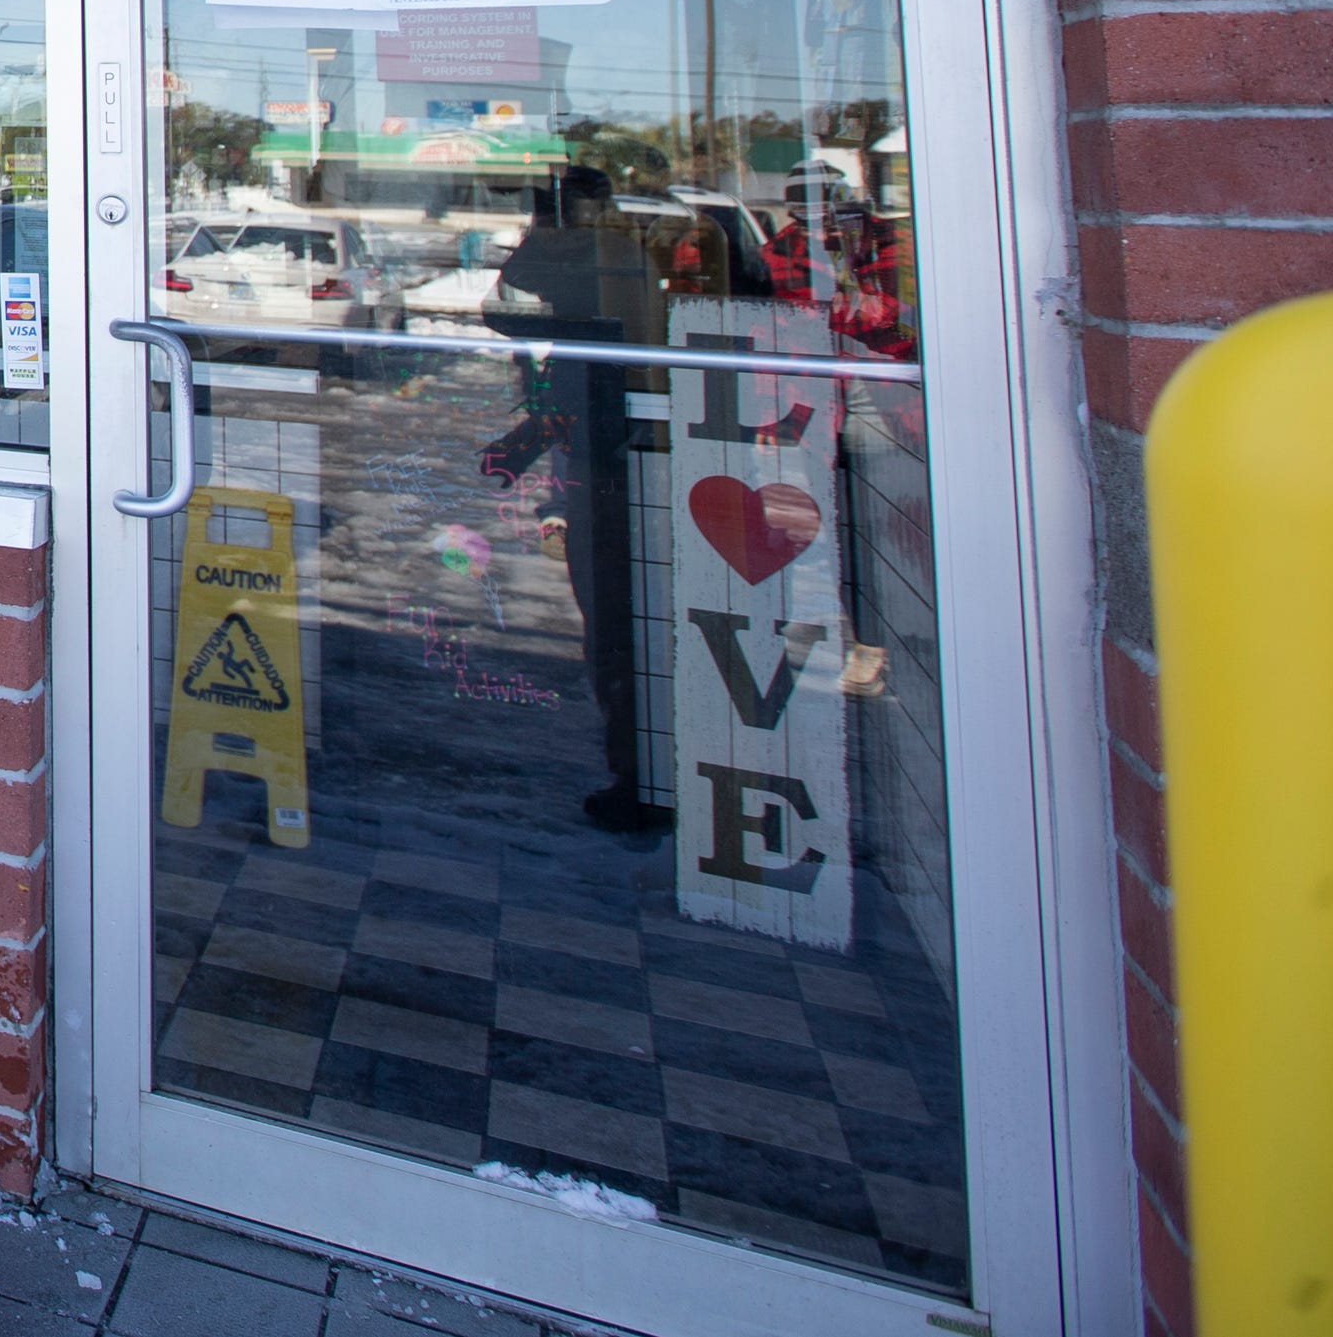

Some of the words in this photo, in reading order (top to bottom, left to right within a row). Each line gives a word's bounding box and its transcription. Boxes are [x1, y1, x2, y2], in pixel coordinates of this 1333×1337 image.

[461, 11, 513, 23] SYSTEM
[517, 11, 532, 21] IN
[408, 27, 436, 37] FOR
[476, 38, 505, 49] AND
[409, 51, 506, 64] INVESTIGATIVE
[422, 65, 494, 76] PURPOSES
[104, 72, 116, 144] PULL
[8, 325, 38, 337] VISA
[195, 564, 282, 593] CAUTION
[386, 593, 454, 635] Fun
[187, 624, 229, 678] CAUTION
[246, 632, 285, 690] CUIDADO
[196, 688, 274, 713] ATTENTION
[453, 668, 561, 711] Activities
